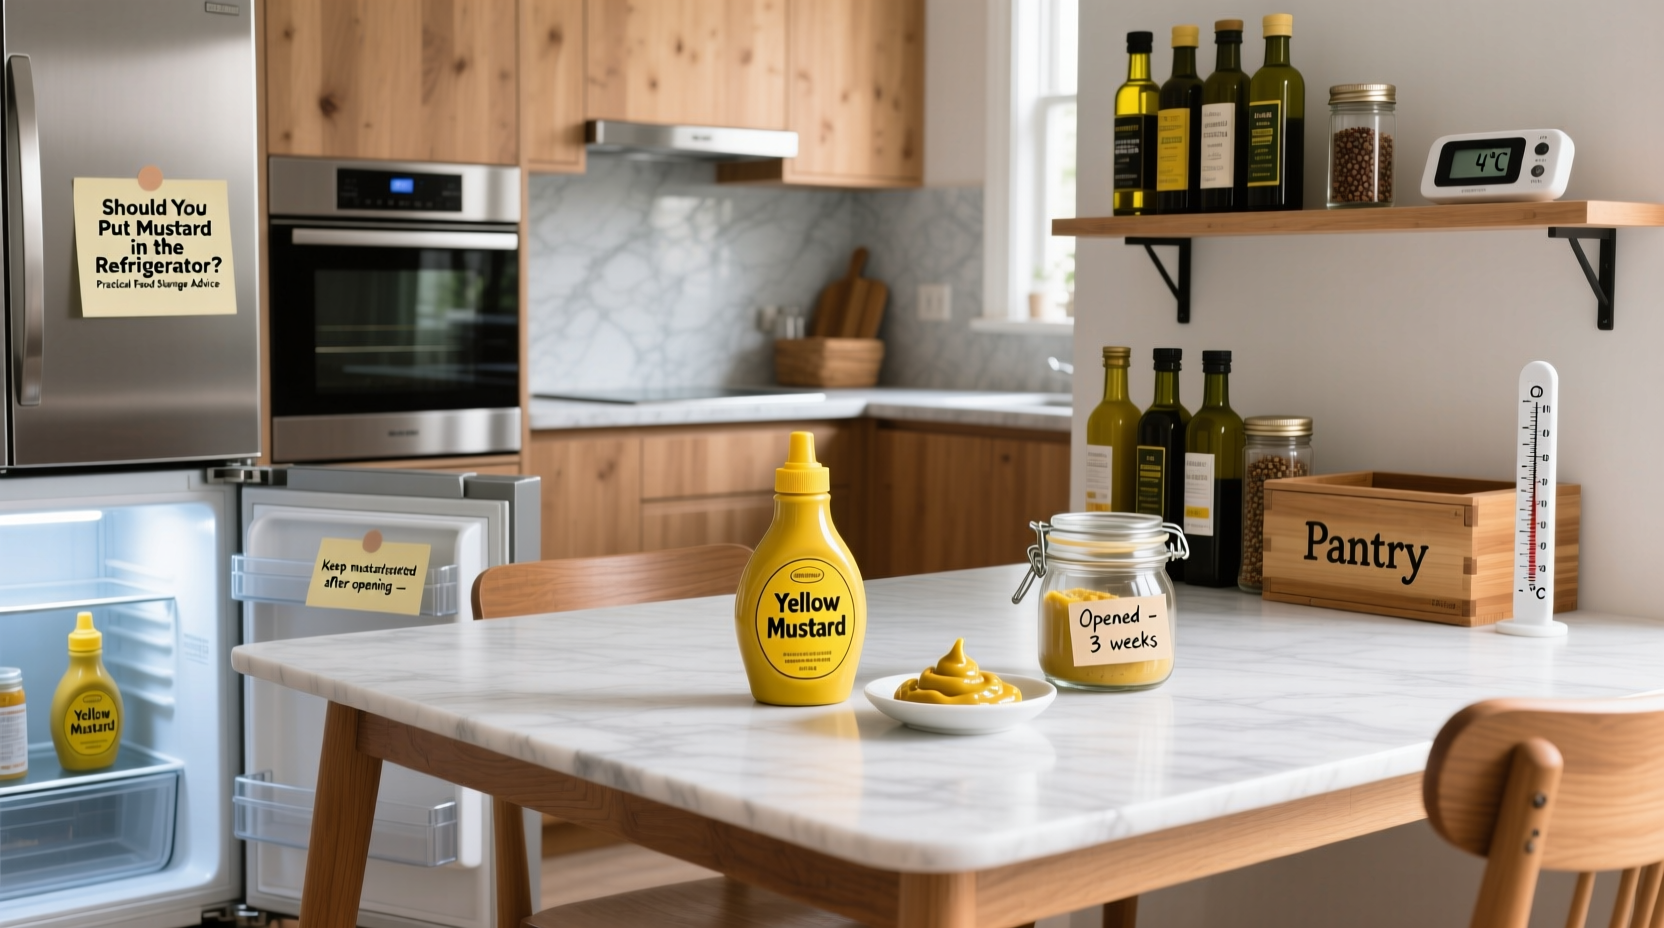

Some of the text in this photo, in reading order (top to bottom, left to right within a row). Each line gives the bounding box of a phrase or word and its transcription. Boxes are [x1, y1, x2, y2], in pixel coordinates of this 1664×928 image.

[102, 198, 207, 216] Should You
[98, 220, 212, 236] Put Mustard
[131, 237, 184, 255] in the
[96, 256, 222, 278] Refrigerator?
[190, 278, 220, 288] Advice
[1303, 520, 1429, 585] Pantry
[321, 558, 347, 575] Keep
[774, 591, 840, 613] Yellow
[767, 614, 846, 639] Mustard
[1079, 604, 1140, 633] Opened
[1089, 630, 1158, 653] 3 weeks
